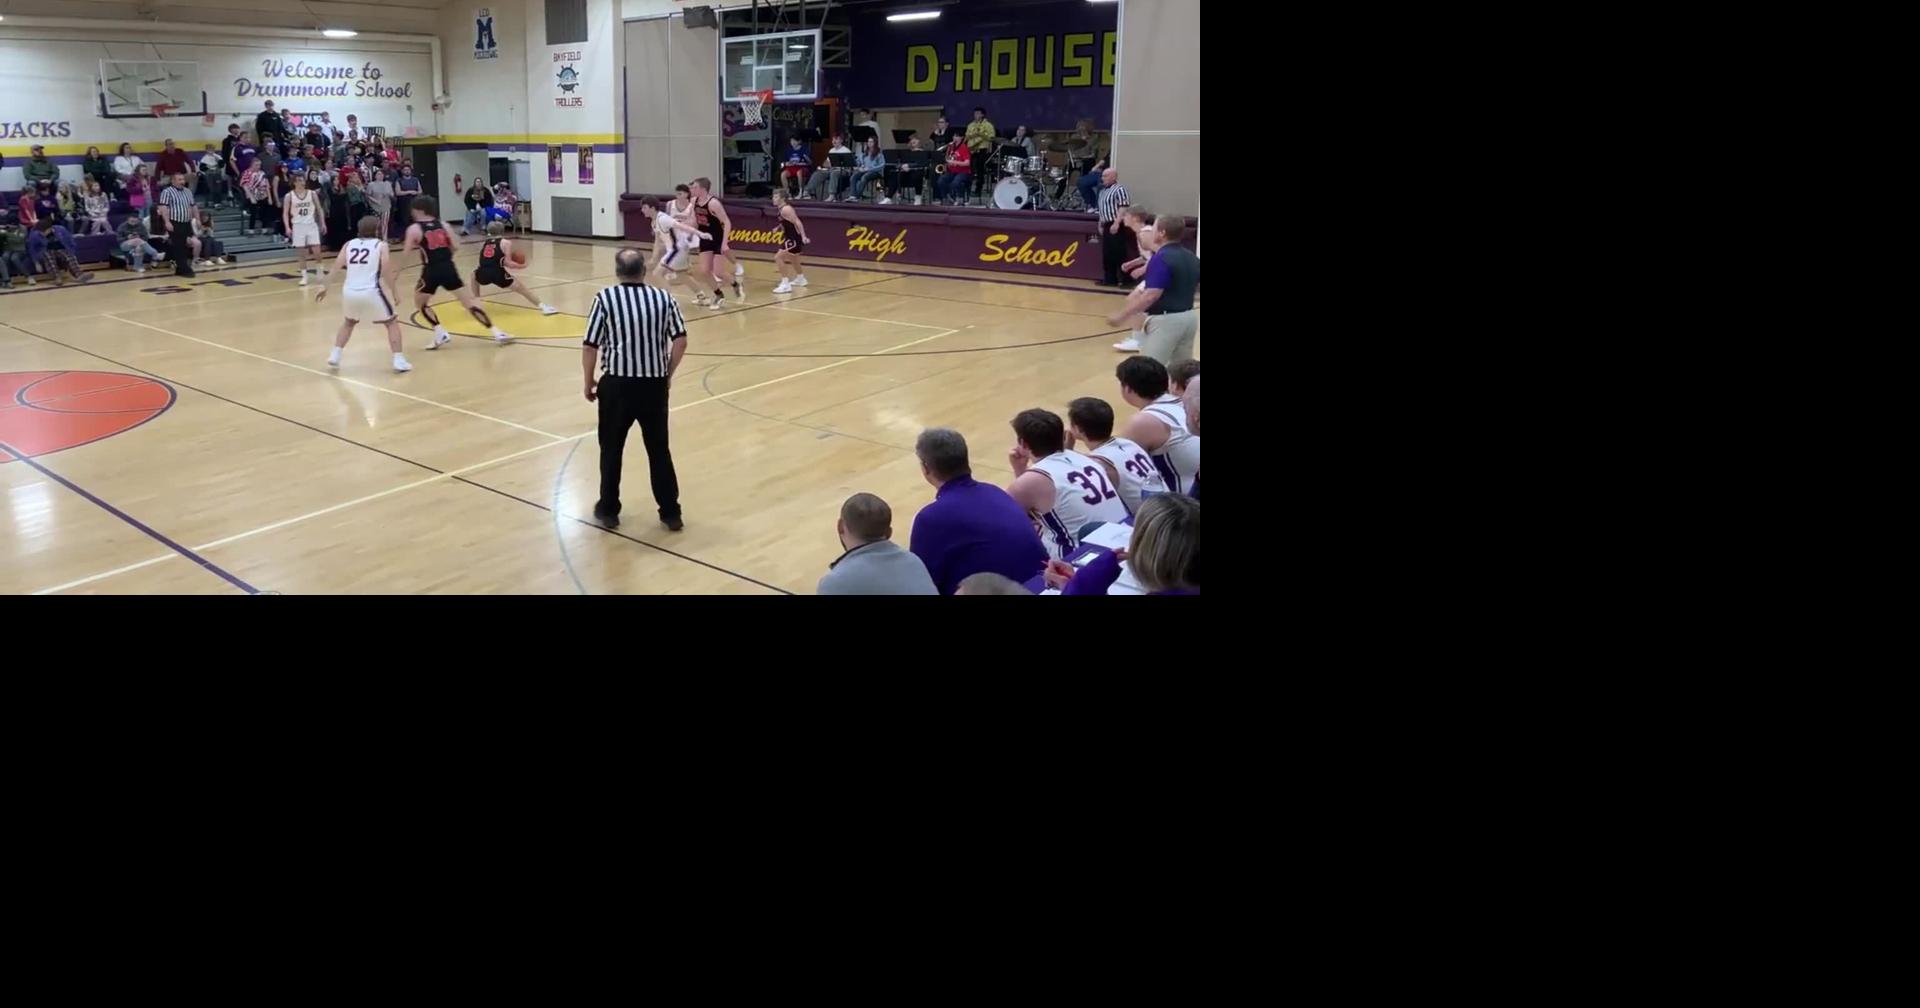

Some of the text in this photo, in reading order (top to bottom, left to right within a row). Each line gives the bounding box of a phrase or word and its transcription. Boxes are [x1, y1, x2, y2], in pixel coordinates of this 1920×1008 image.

[553, 51, 582, 62] BAYFIELD
[262, 59, 383, 80] Welcome to
[233, 78, 413, 98] Drummond School
[0, 121, 71, 139] JACKS
[298, 208, 309, 216] 40
[349, 248, 370, 264] 22
[846, 226, 907, 262] High
[979, 234, 1079, 268] School
[1067, 465, 1117, 506] 32
